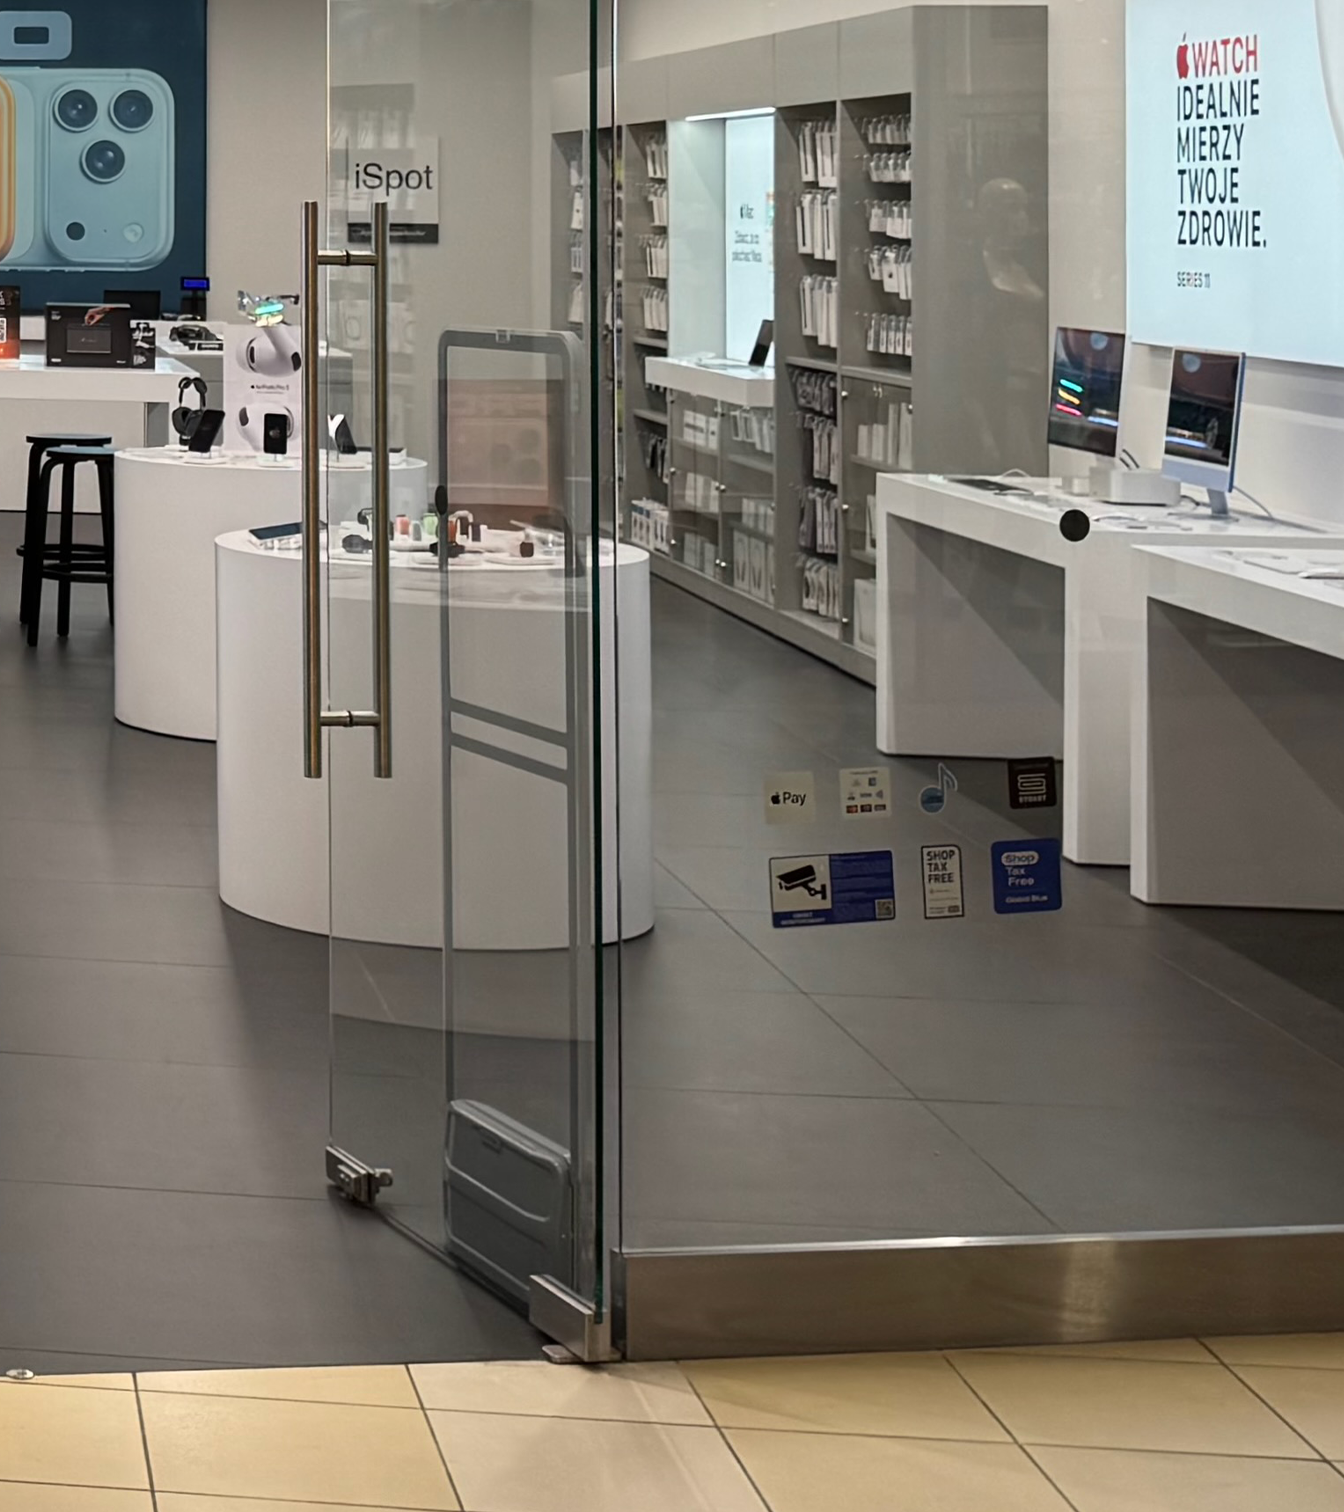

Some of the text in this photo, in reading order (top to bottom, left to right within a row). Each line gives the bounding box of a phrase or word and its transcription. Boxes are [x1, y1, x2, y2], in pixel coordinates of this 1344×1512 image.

[1192, 34, 1258, 79] WATCH
[1176, 79, 1260, 122] IDEALNIE
[1176, 123, 1245, 163] MIERZY
[355, 162, 434, 196] iSpot
[1177, 167, 1240, 205] TWOJE
[1177, 209, 1267, 248] ZDROWIE.
[1176, 271, 1203, 288] SERIES
[782, 791, 807, 807] Pay
[926, 850, 956, 862] SHOP
[1005, 854, 1035, 865] Shop
[927, 862, 948, 873] TAX
[1006, 867, 1026, 876] Tax
[928, 872, 954, 884] FREE
[1008, 876, 1035, 887] Free
